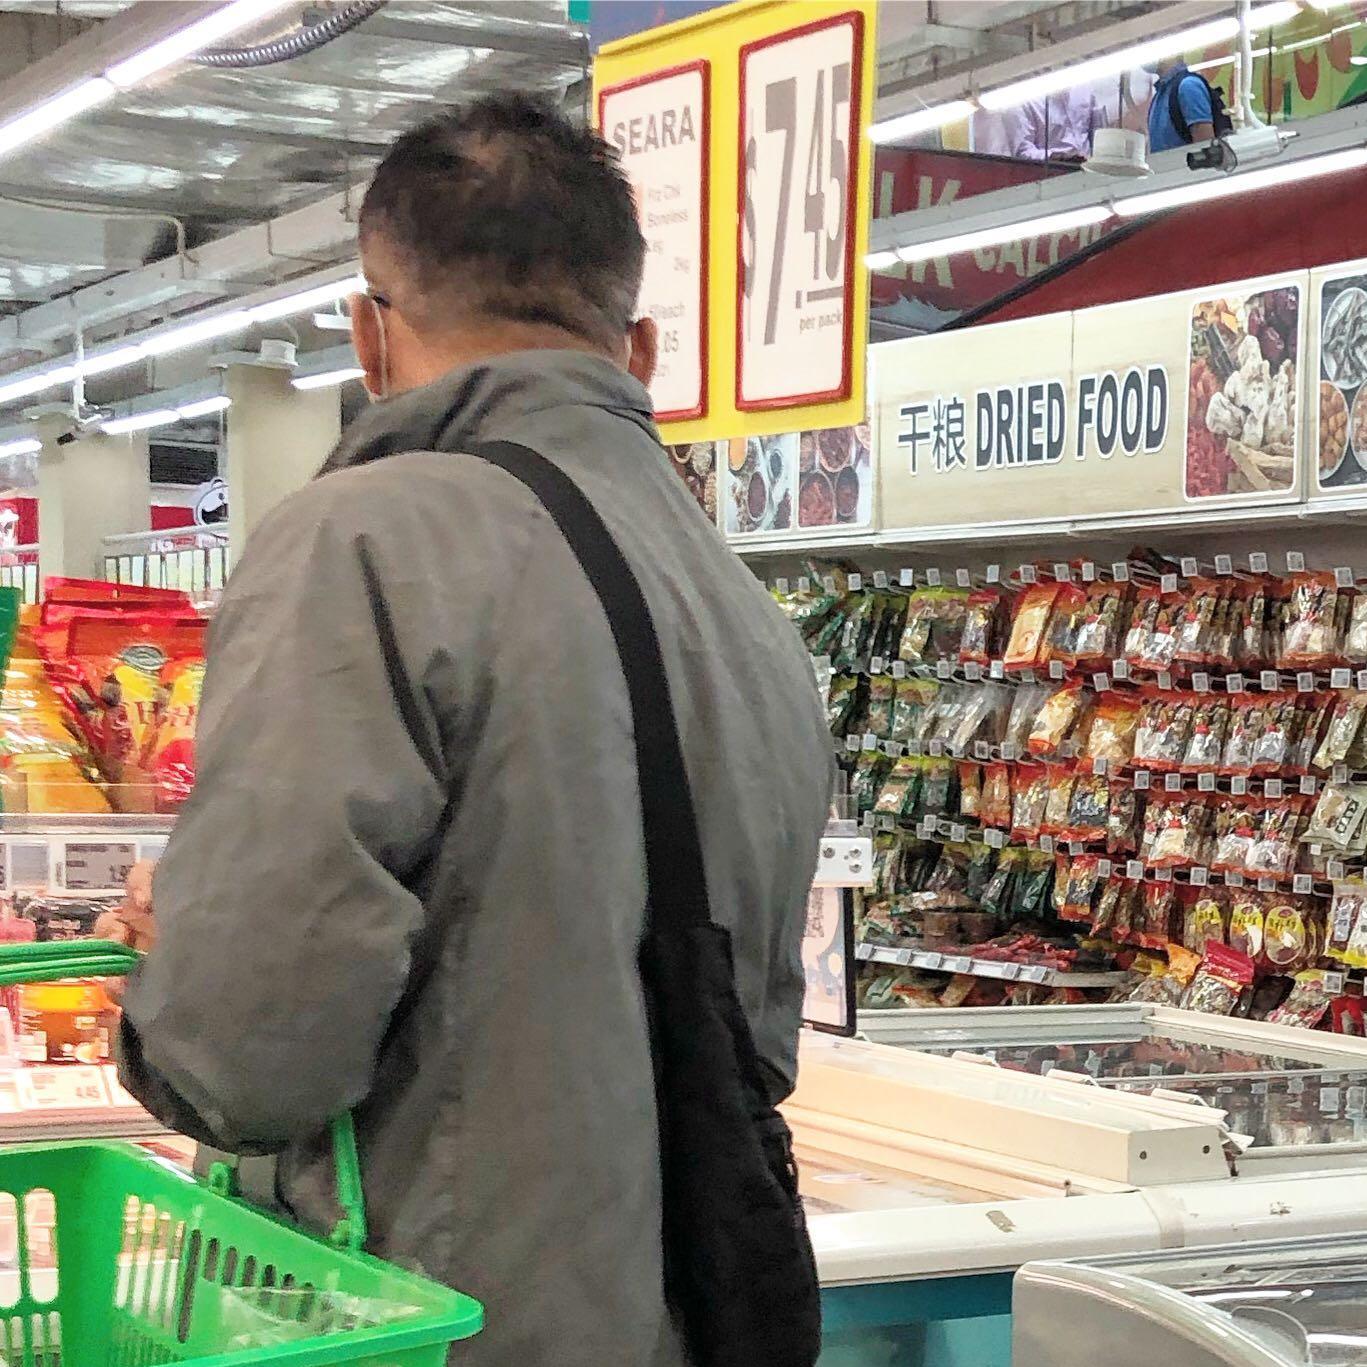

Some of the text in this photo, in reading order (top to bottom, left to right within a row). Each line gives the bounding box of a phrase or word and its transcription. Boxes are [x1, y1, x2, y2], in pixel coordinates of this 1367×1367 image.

[612, 104, 697, 155] SEARA
[799, 309, 843, 331] per pack
[898, 367, 1167, 475] 干粮 DRIED FOOD
